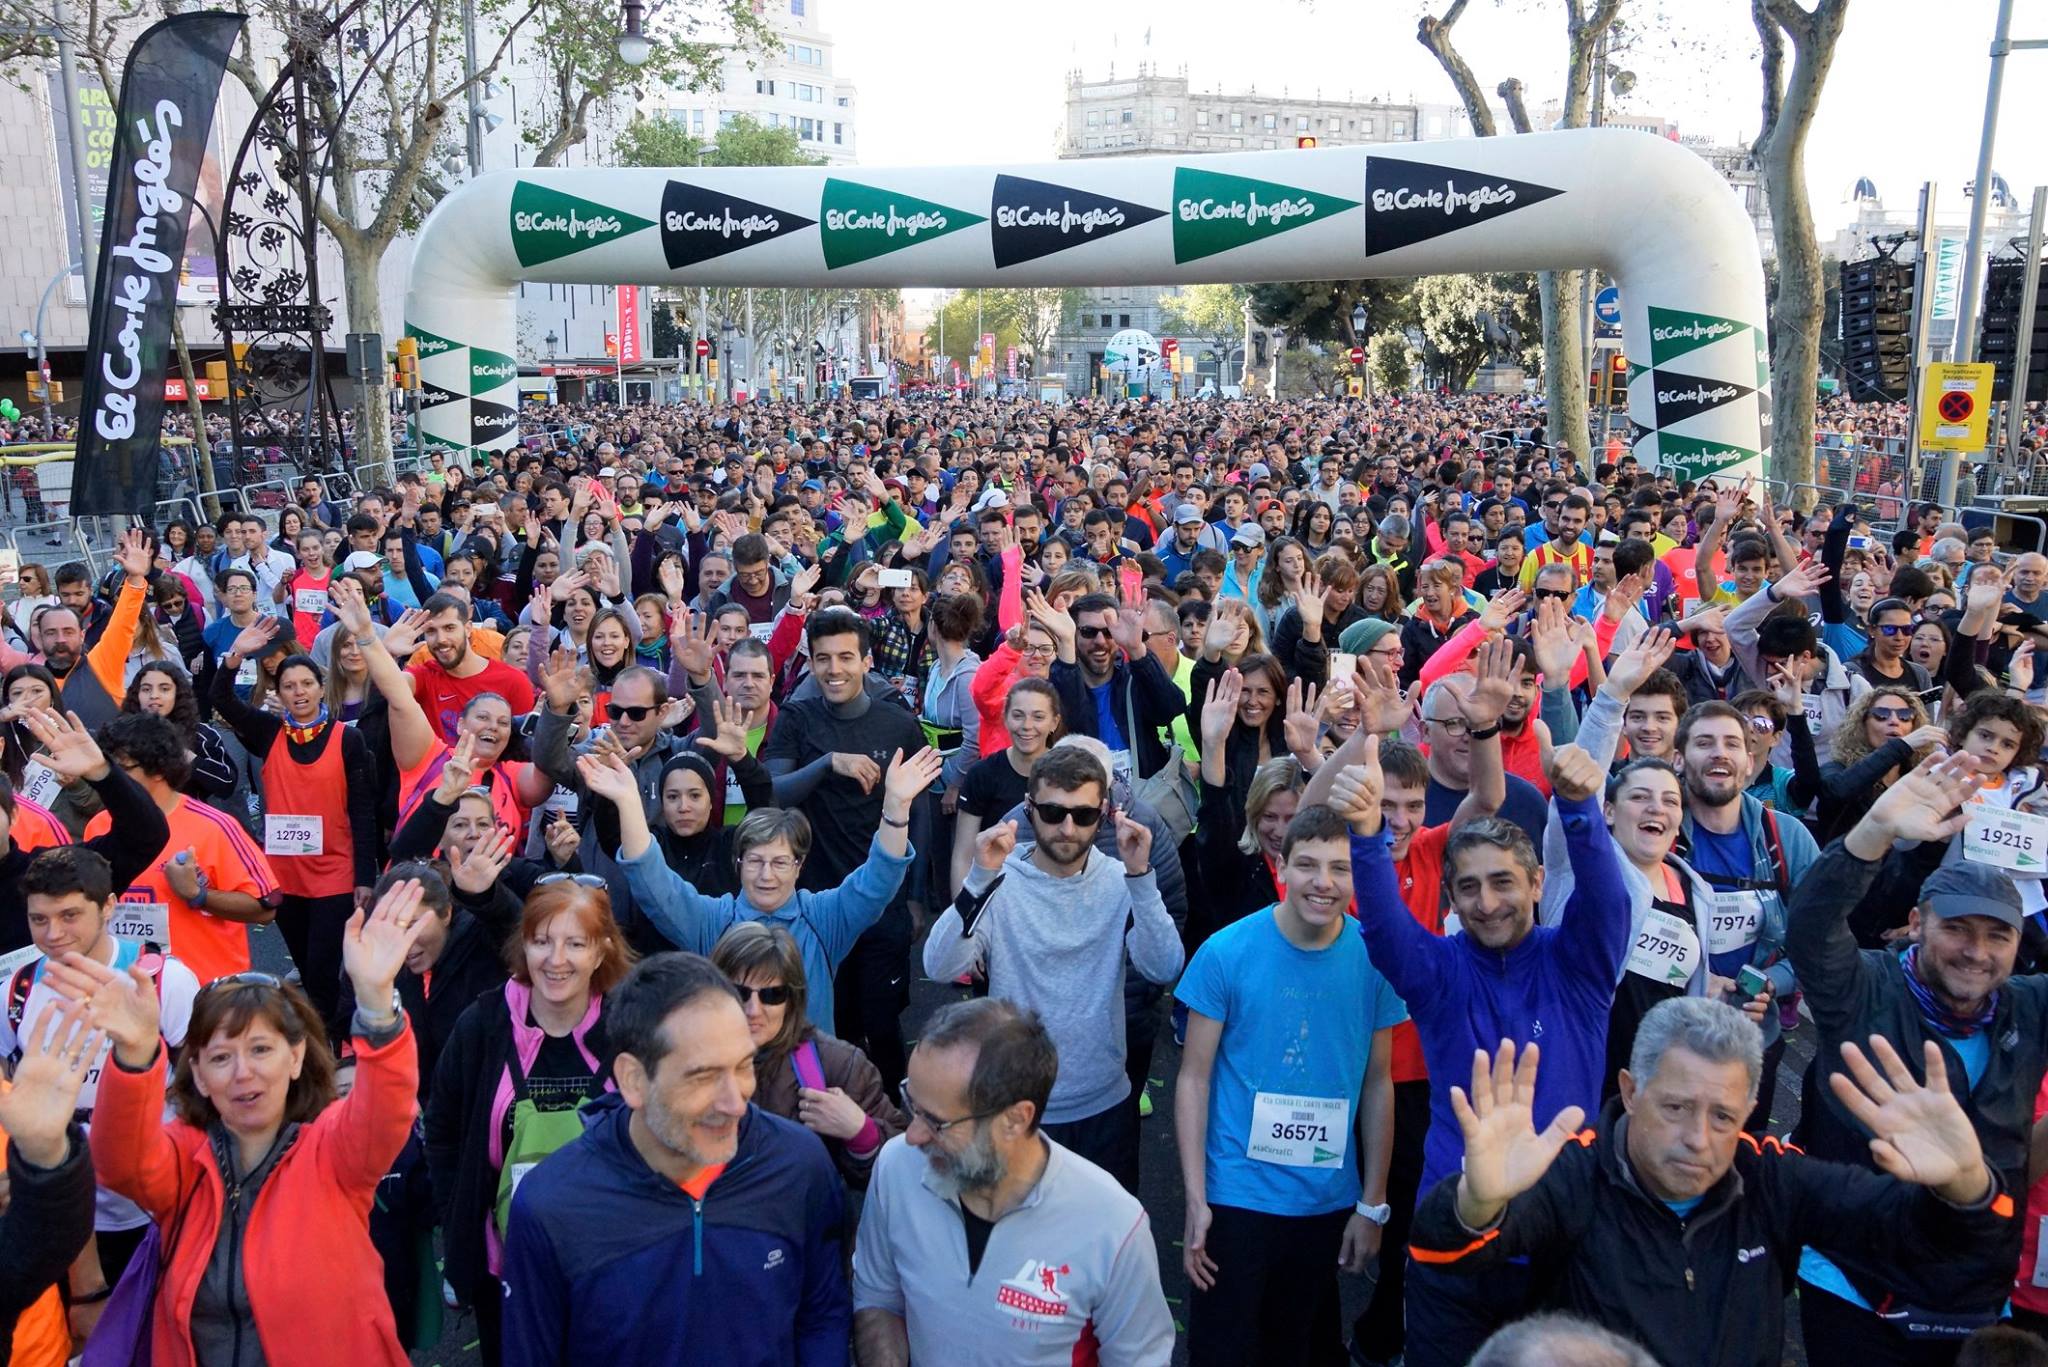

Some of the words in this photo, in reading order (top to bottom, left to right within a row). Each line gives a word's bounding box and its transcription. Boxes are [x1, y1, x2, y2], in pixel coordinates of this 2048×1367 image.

[113, 99, 182, 273] Inglés
[1372, 188, 1393, 212] El
[1390, 187, 1443, 210] Corte
[1443, 180, 1516, 215] Inglés
[826, 208, 844, 229] El
[841, 209, 885, 229] Corte
[885, 204, 947, 237] Inglés
[997, 205, 1016, 227] El
[1012, 205, 1060, 226] Corte
[1060, 201, 1125, 233] Inglés
[1178, 198, 1198, 221] El
[1197, 198, 1246, 220] Corte
[1245, 192, 1315, 226] Inglés
[515, 211, 533, 231] El
[531, 212, 568, 232] Corte
[568, 208, 622, 239] Inglés
[666, 210, 684, 231] El
[681, 211, 722, 231] Corte
[722, 207, 779, 238] Inglés
[103, 275, 150, 390] Corte
[1653, 327, 1665, 341] El
[1664, 324, 1694, 340] Corte
[1692, 320, 1733, 341] Inglés
[482, 364, 501, 376] Corte
[165, 384, 182, 395] DE
[1658, 391, 1671, 404] El
[1669, 388, 1697, 403] Corte
[1697, 384, 1738, 404] Inglés
[96, 392, 136, 440] El
[483, 415, 503, 427] Corte
[1673, 451, 1701, 465] Corte
[1701, 447, 1741, 467] Inglés
[276, 830, 311, 841] 12739
[1980, 827, 2034, 850] 19215
[115, 922, 154, 936] 11725
[1636, 932, 1688, 962] 27975
[1271, 1122, 1329, 1142] 36571
